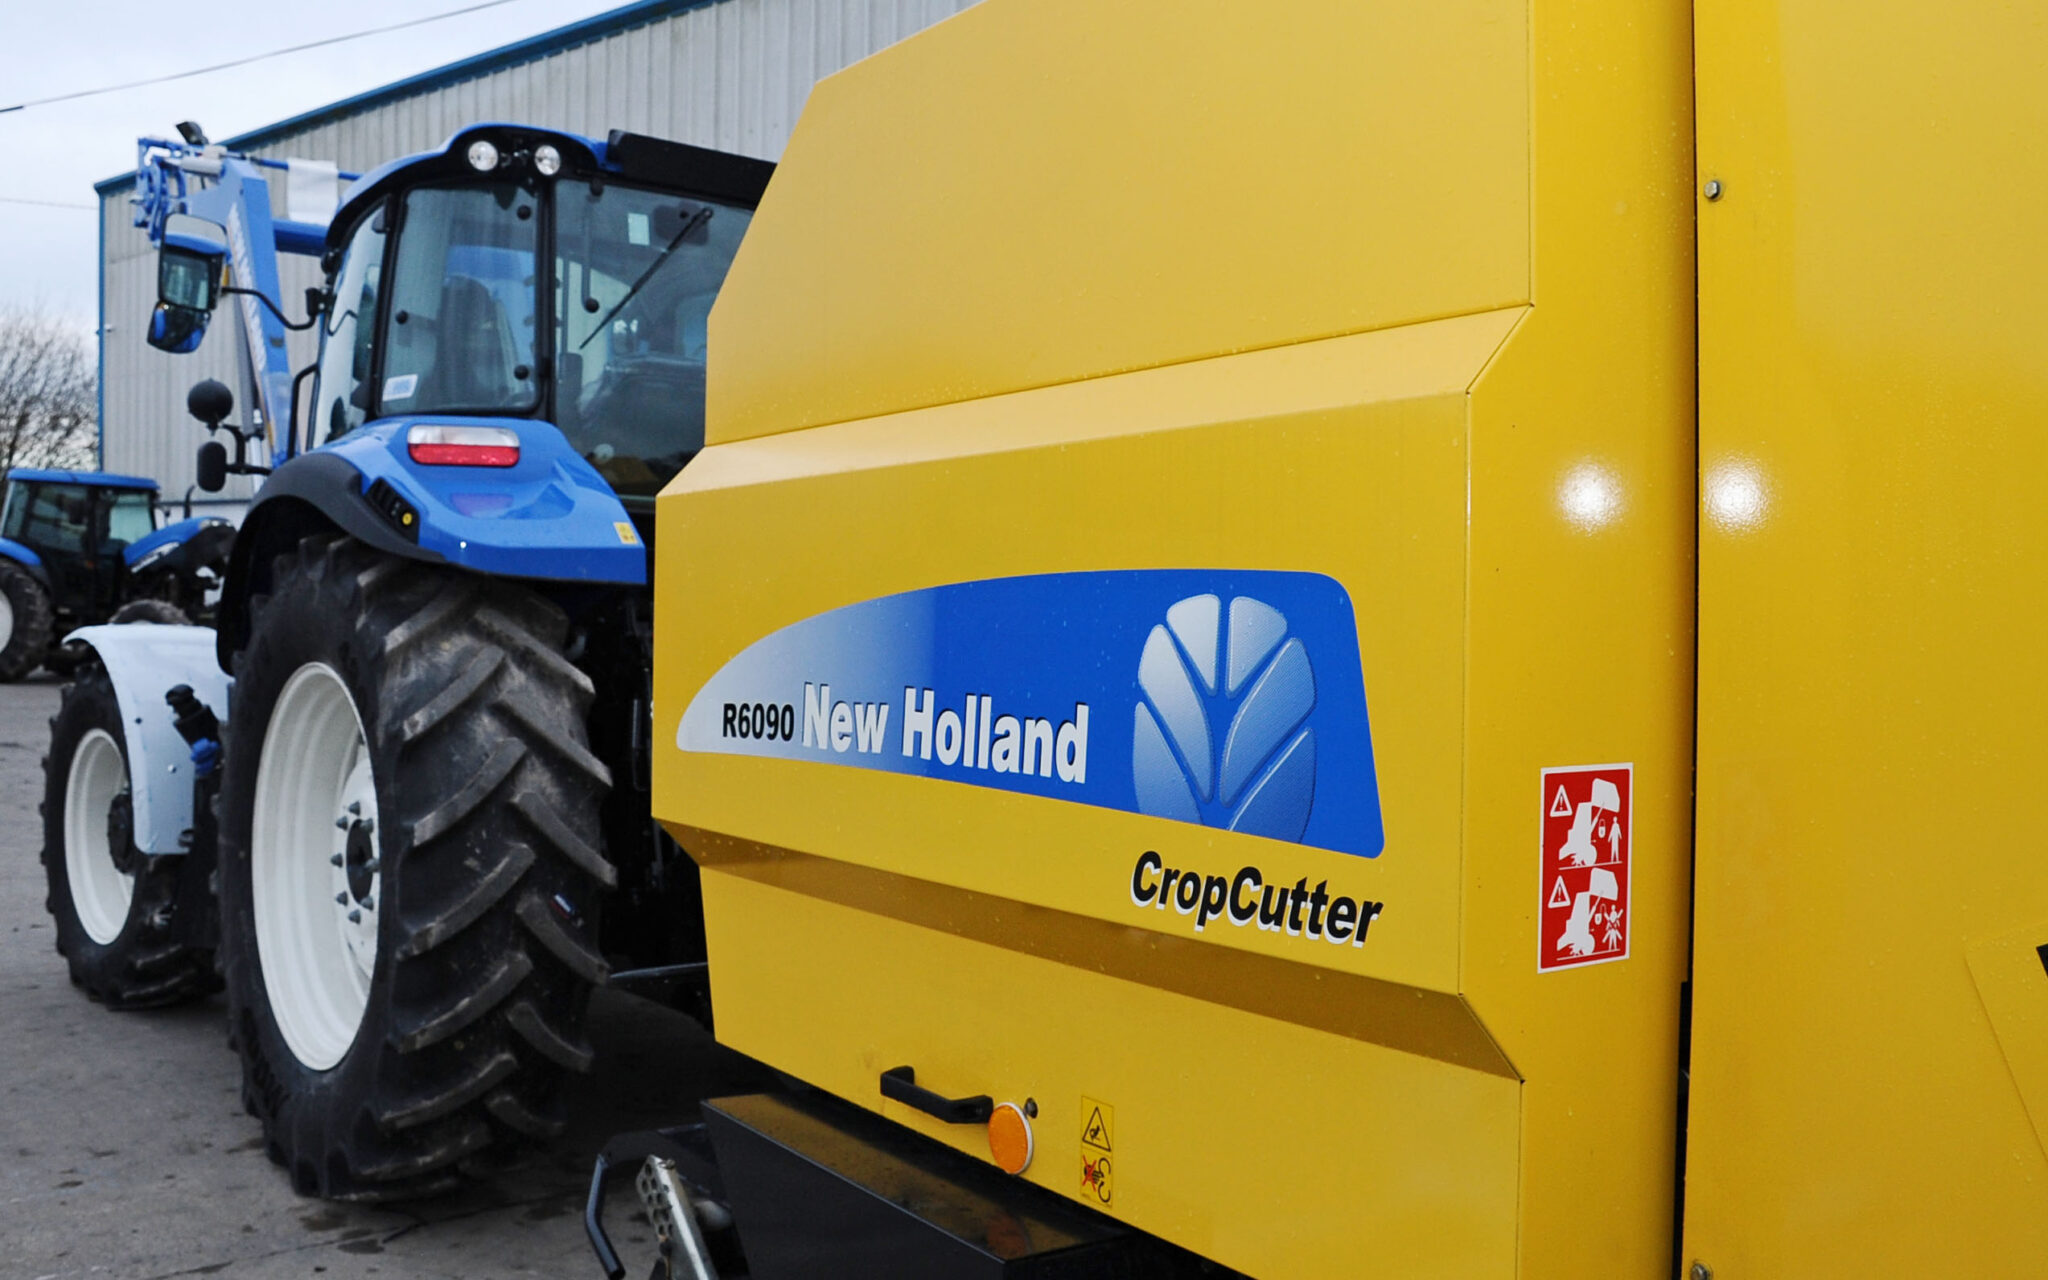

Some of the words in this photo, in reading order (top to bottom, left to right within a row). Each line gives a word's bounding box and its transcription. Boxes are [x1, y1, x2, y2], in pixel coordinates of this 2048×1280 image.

[722, 703, 795, 742] R6090
[803, 682, 888, 754] New
[902, 686, 1089, 784] Holland
[1131, 850, 1383, 947] CropCutter
